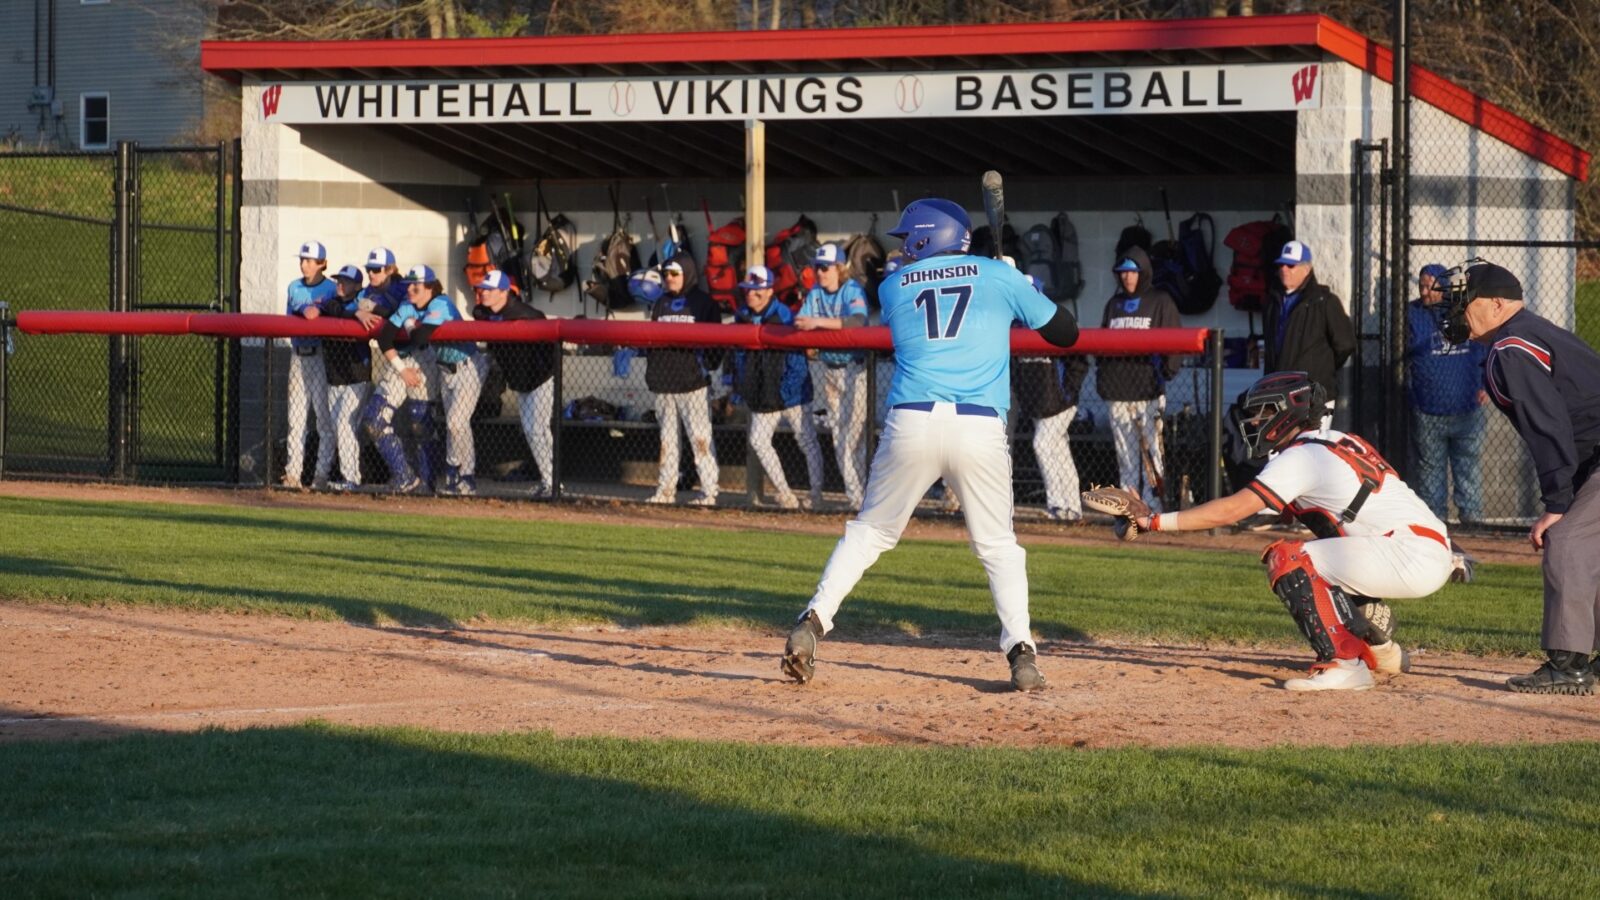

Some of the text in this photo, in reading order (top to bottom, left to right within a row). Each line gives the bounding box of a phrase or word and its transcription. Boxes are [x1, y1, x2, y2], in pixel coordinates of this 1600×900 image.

[262, 84, 282, 119] W
[315, 69, 1243, 118] WHITEHALL VIKINGS BASEBALL
[1292, 64, 1318, 105] W
[900, 264, 979, 287] JOHNSON
[914, 284, 973, 341] 17
